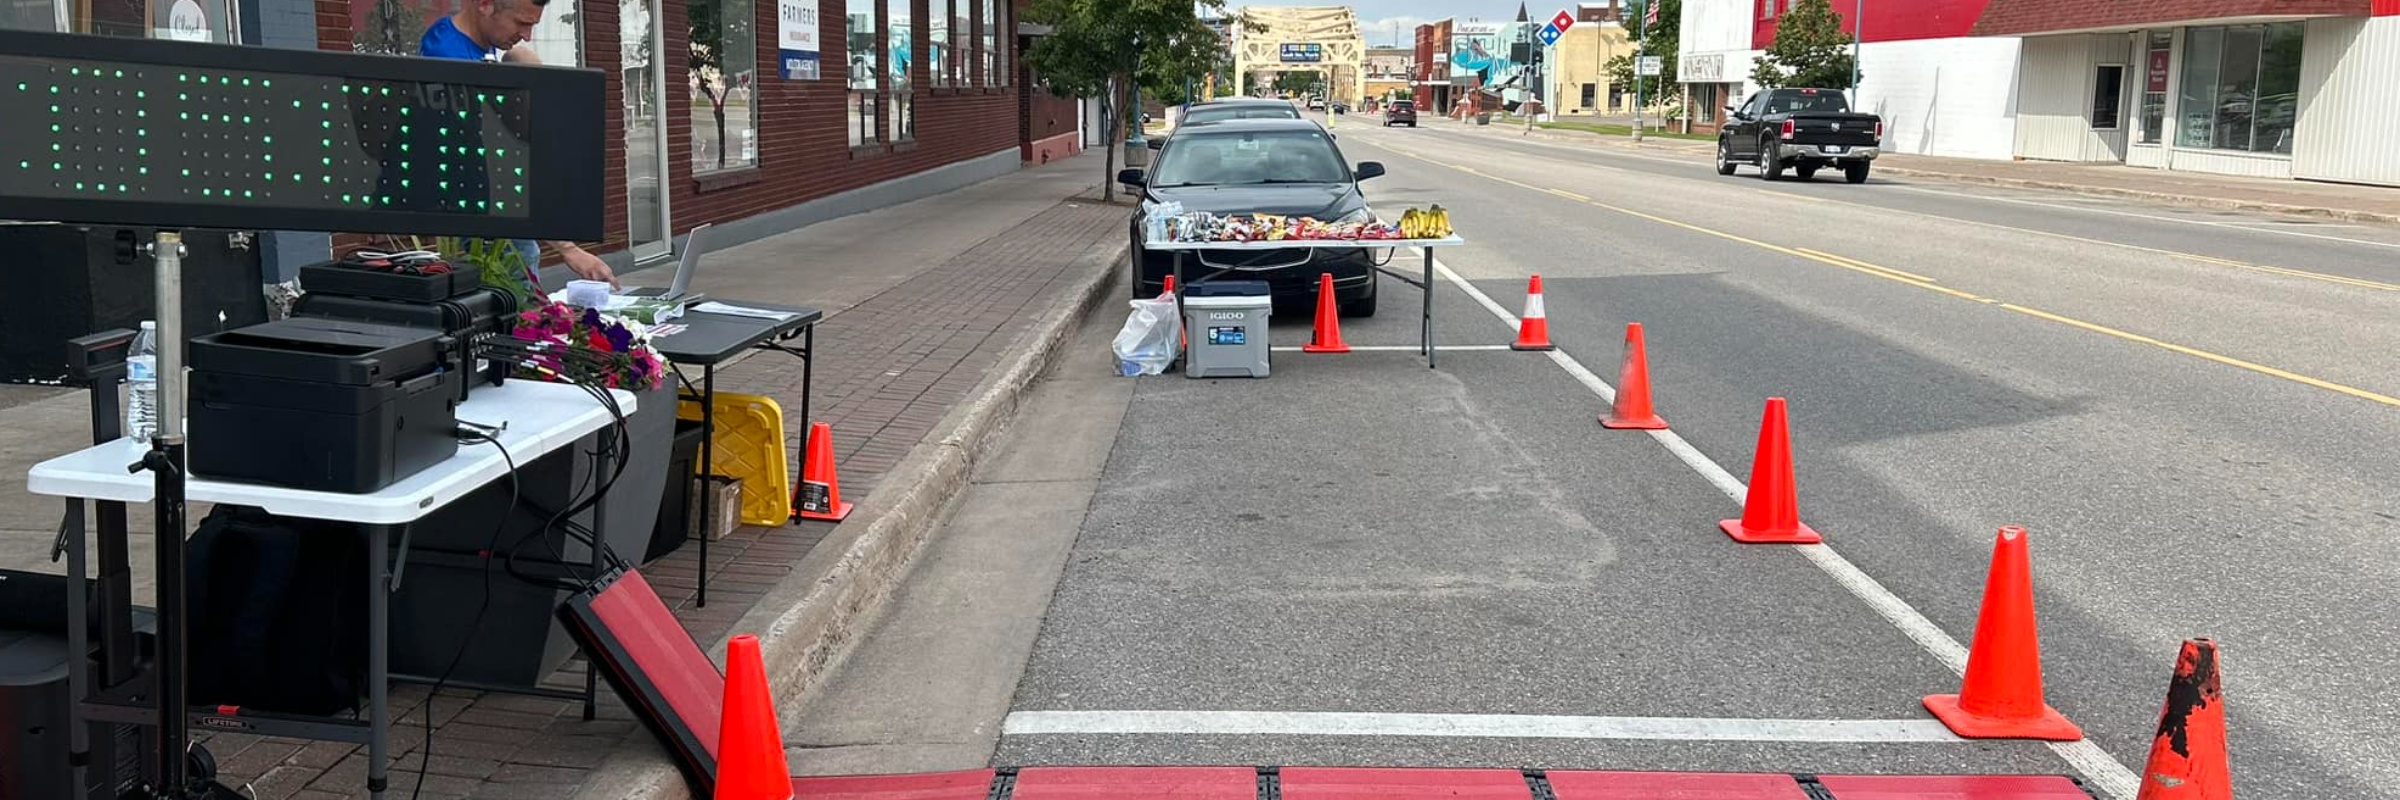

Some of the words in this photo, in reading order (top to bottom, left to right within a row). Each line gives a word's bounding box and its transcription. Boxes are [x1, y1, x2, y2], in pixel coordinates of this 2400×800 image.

[783, 4, 815, 26] FARMERS
[1209, 312, 1244, 320] IGLOO
[1209, 328, 1218, 339] 5
